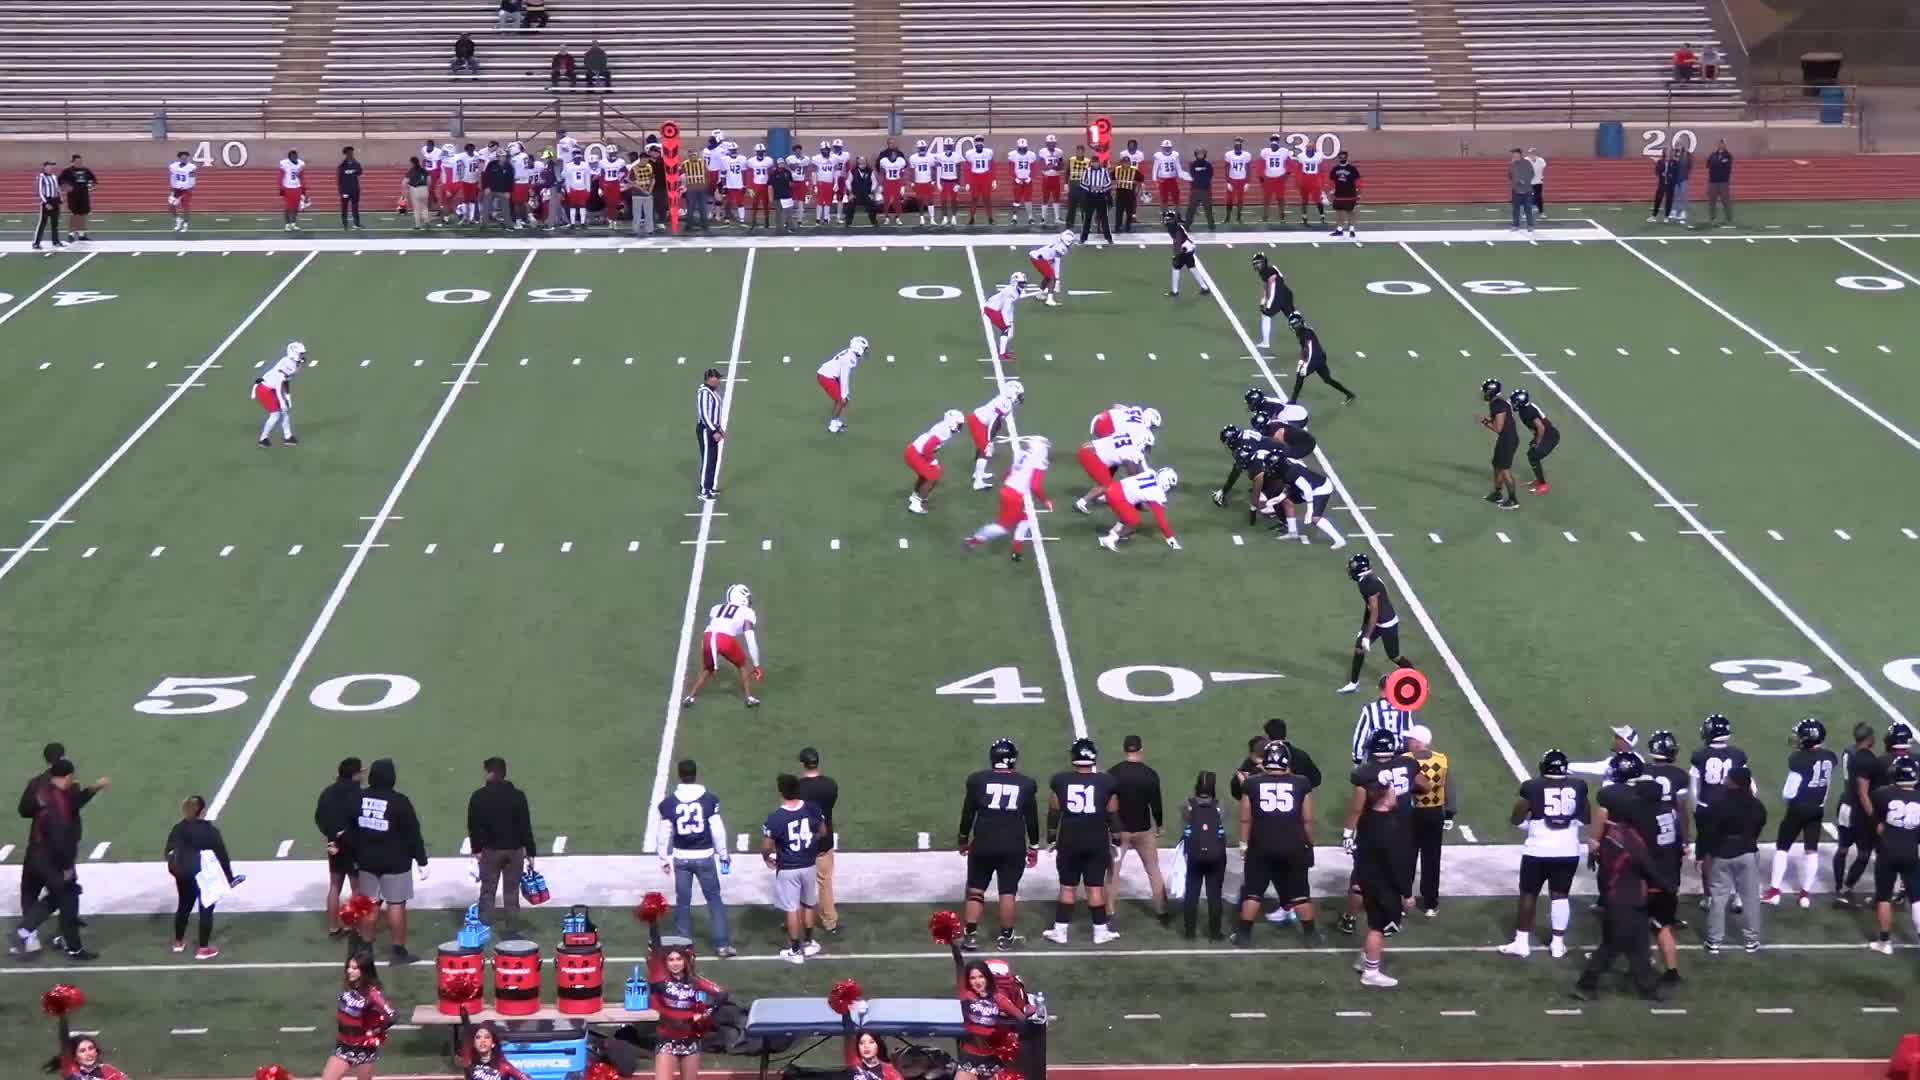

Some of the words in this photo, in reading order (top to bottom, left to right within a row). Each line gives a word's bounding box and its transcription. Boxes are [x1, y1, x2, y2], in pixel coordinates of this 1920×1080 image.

[1090, 125, 1099, 142] 1
[1286, 133, 1341, 160] 30
[1642, 130, 1697, 158] 20
[193, 140, 249, 167] 40
[985, 783, 1021, 810] 77
[1066, 783, 1096, 814] 51
[1259, 782, 1294, 812] 55
[1543, 786, 1577, 816] 56
[674, 802, 705, 836] 23
[786, 817, 814, 853] 54
